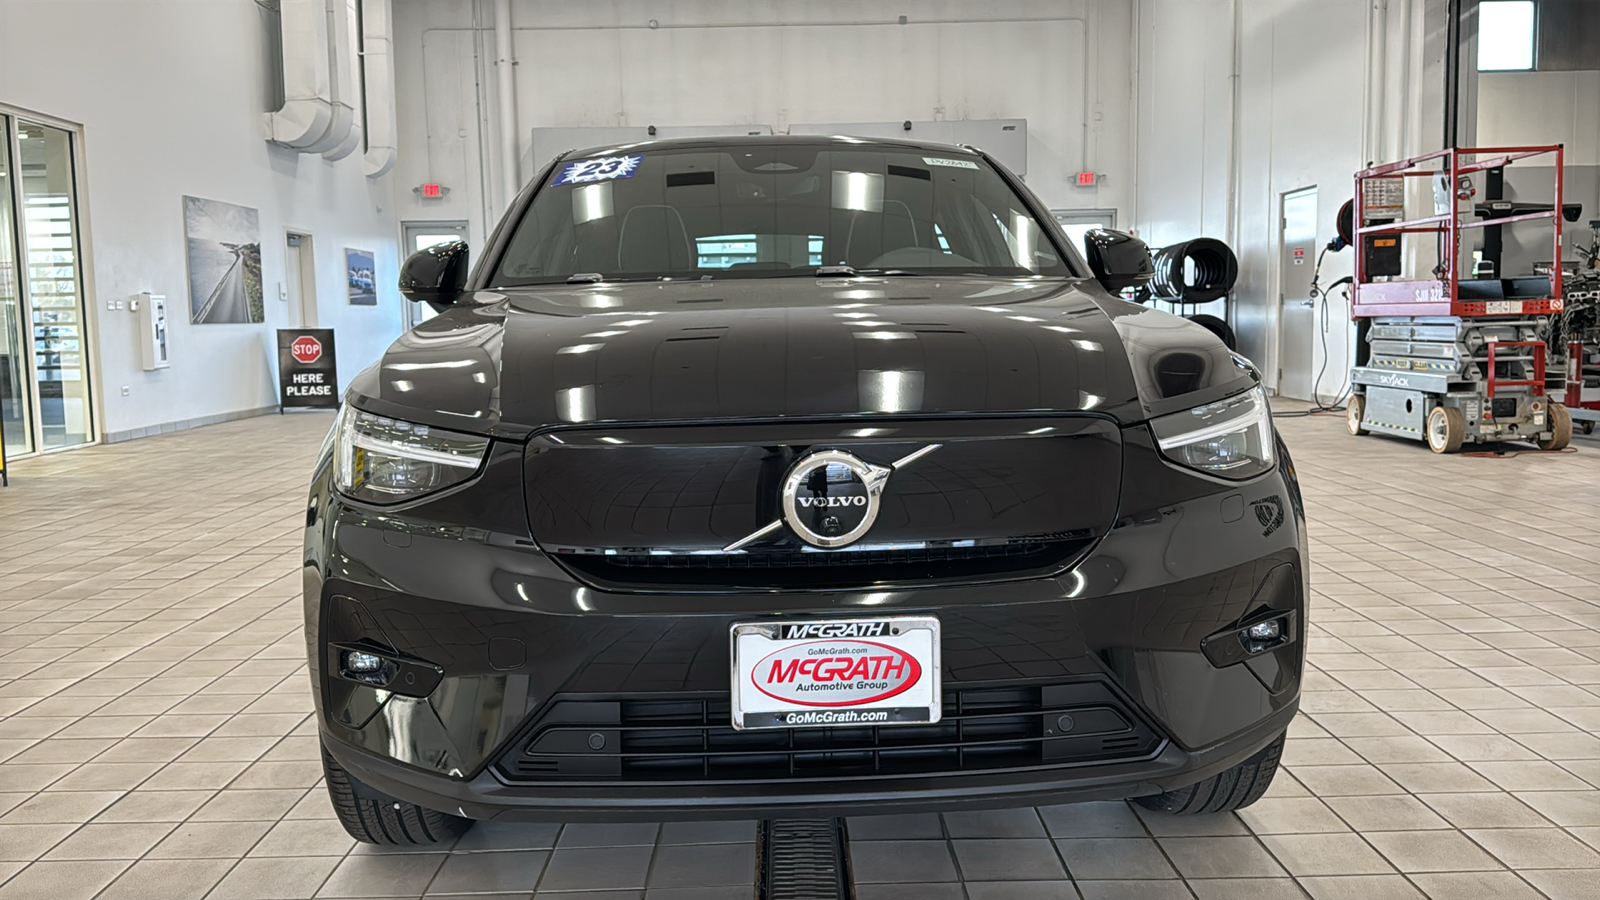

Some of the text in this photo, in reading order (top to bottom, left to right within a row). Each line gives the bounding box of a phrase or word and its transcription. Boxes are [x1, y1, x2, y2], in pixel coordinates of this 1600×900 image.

[576, 160, 623, 177] 23
[294, 344, 320, 355] STOP
[293, 373, 324, 384] HERE
[1380, 373, 1409, 387] SKYJACK
[286, 385, 331, 396] PLEASE
[797, 495, 867, 508] VOLVO
[786, 622, 883, 639] McGRATH
[807, 647, 868, 656] GoMcGrath.com
[766, 656, 907, 684] McGRATH
[795, 681, 888, 692] Automotive Group
[786, 711, 888, 724] GoMcGrath.com
